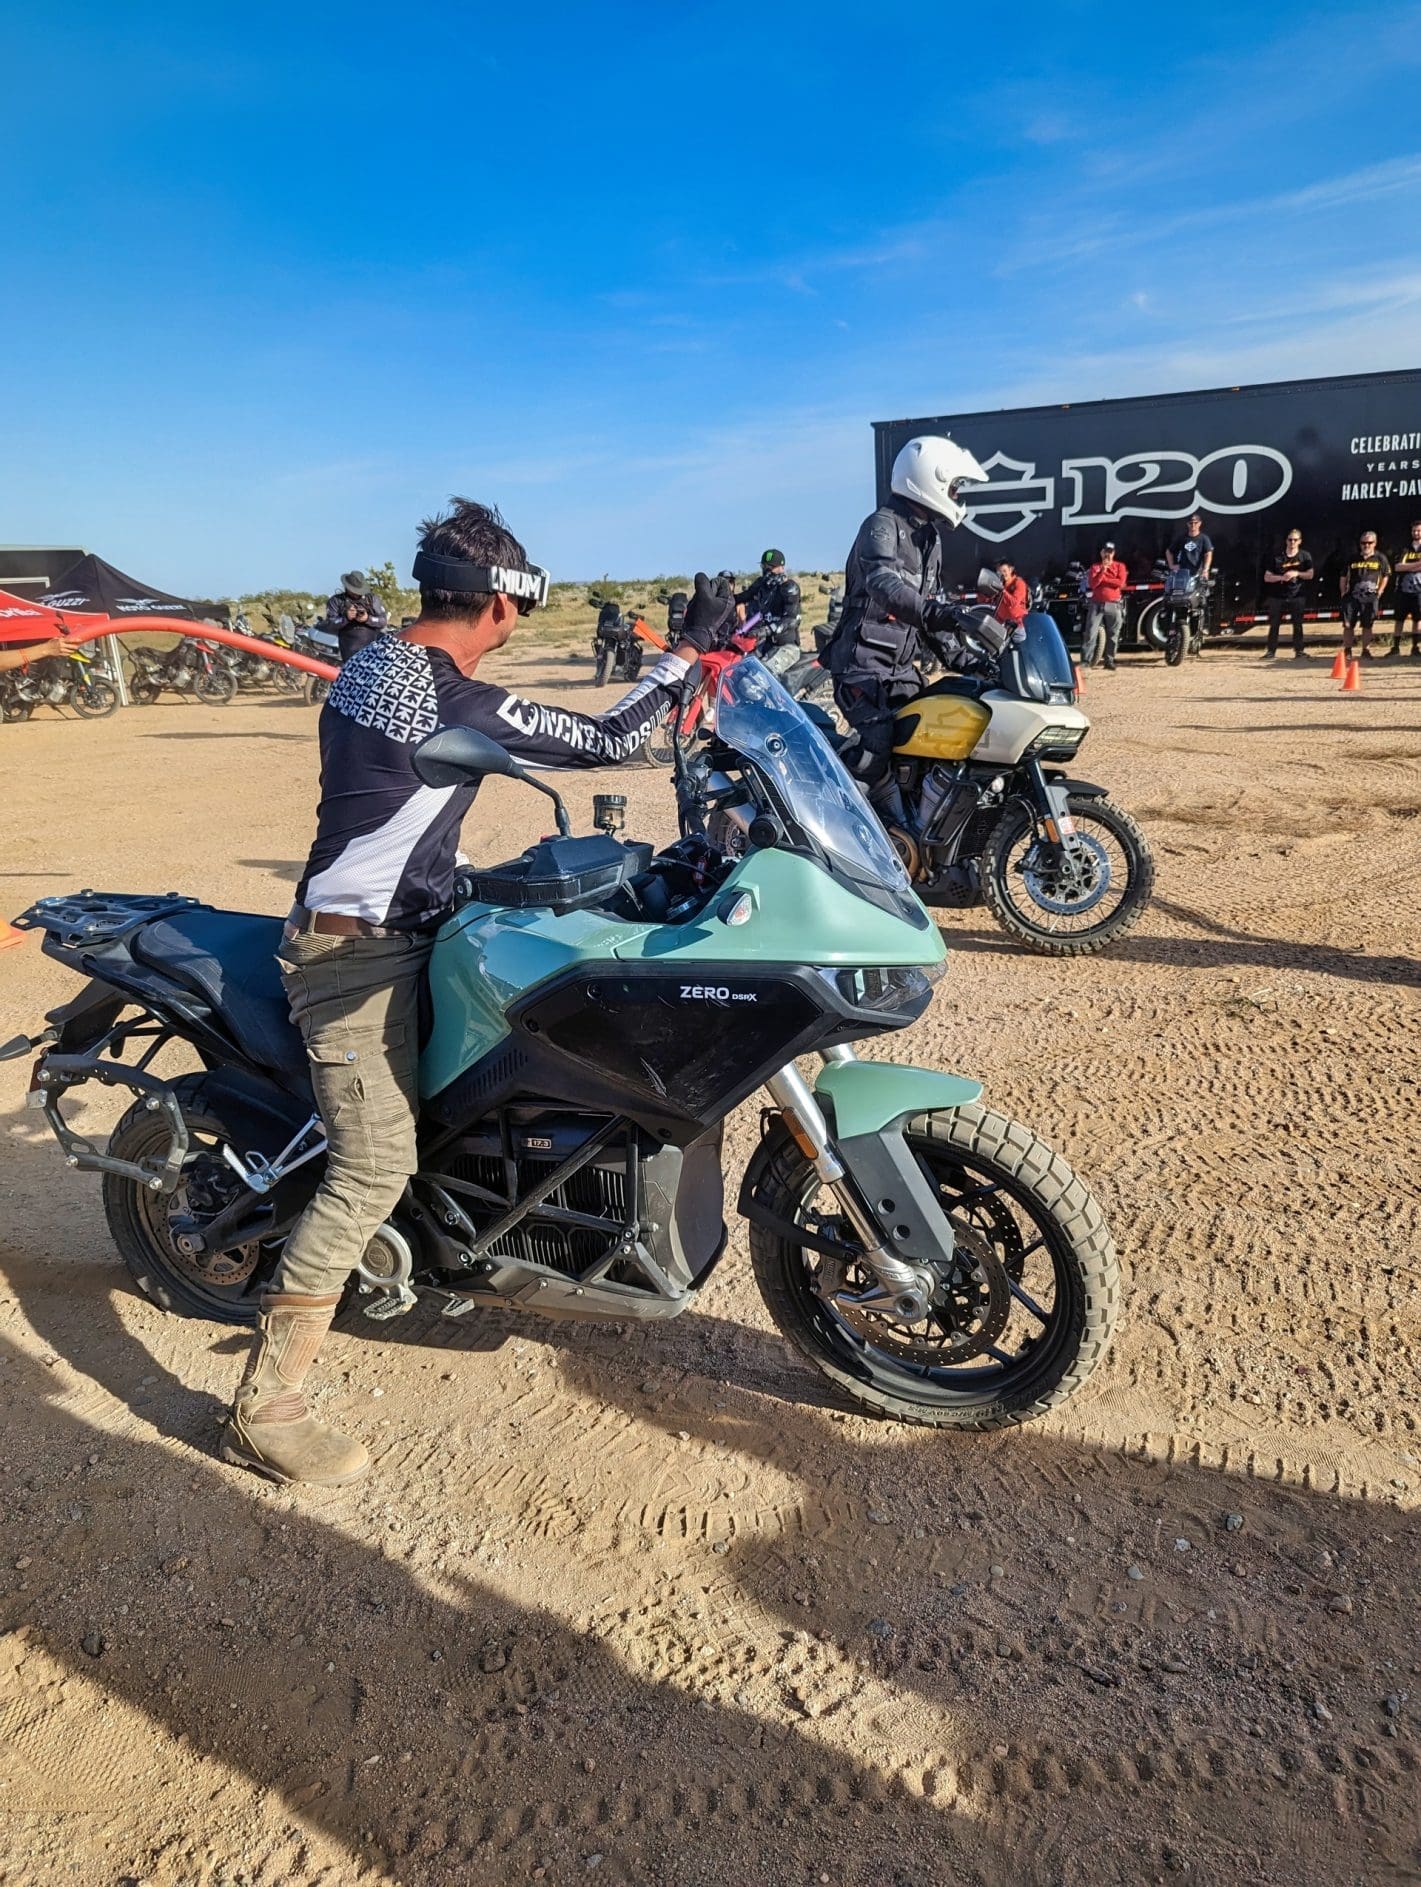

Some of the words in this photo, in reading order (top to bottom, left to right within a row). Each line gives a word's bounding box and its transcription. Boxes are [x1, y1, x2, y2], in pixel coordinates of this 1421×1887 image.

[1351, 432, 1421, 454] CELEBRATI
[1366, 460, 1420, 473] YEARS
[1062, 444, 1293, 525] 120
[679, 986, 730, 1000] ZERO
